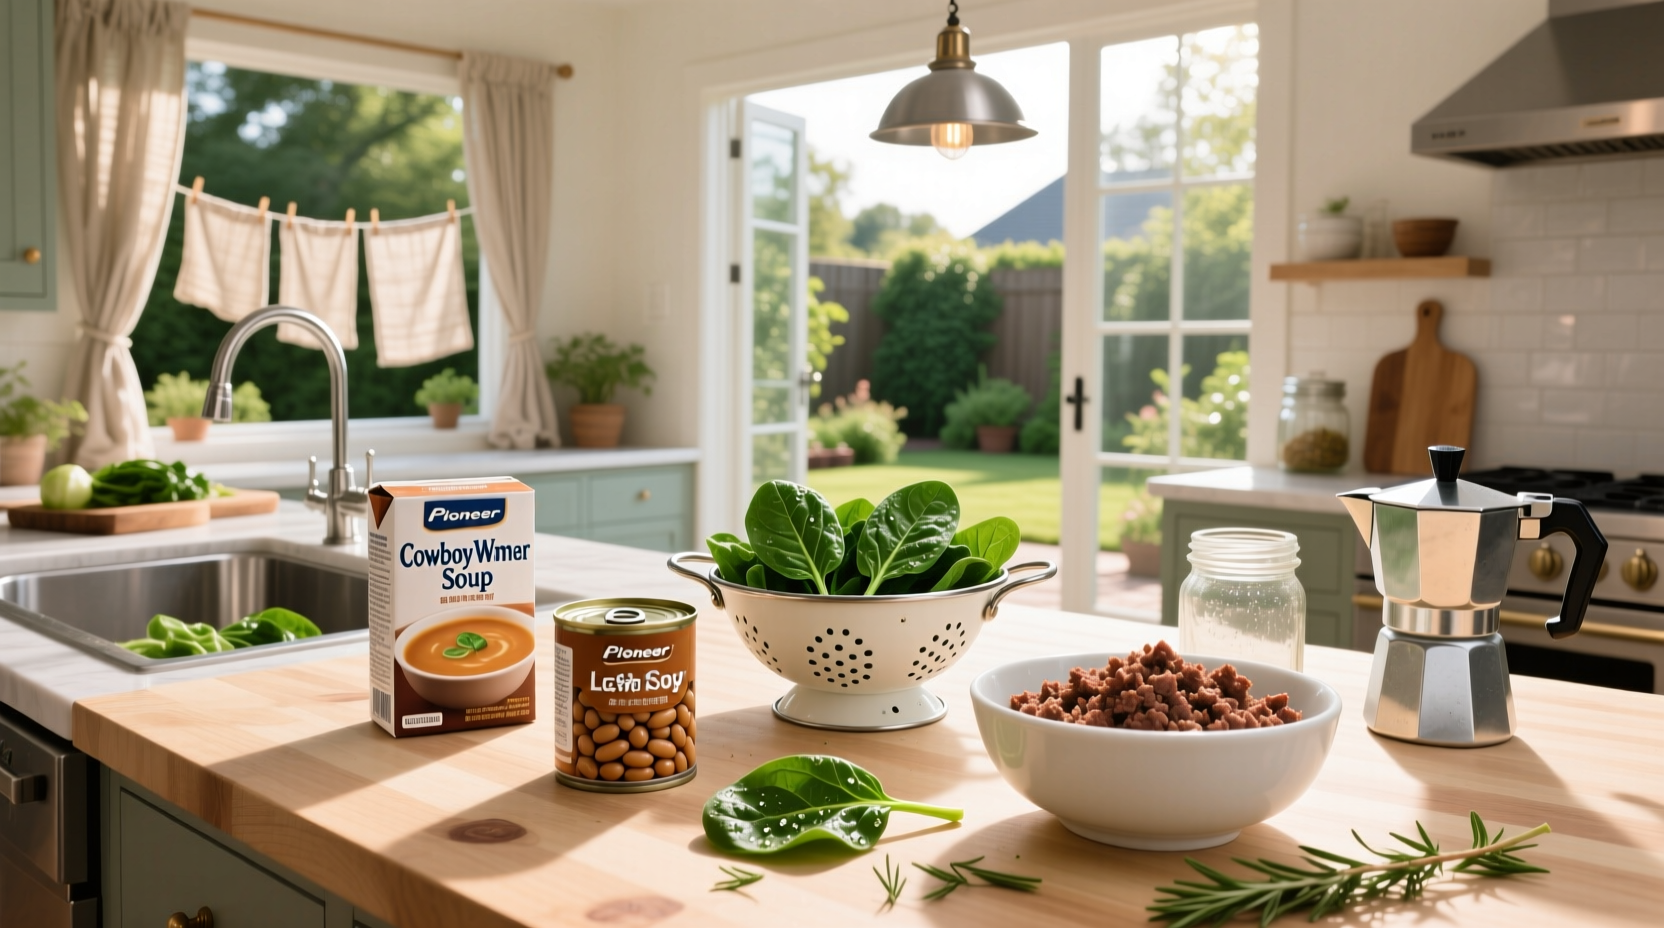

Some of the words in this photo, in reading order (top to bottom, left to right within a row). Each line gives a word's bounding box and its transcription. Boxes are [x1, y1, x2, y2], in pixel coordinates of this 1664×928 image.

[428, 507, 501, 522] Pioneer
[400, 541, 473, 570] Cowboy
[442, 568, 493, 592] Soup
[645, 669, 684, 693] Soy
